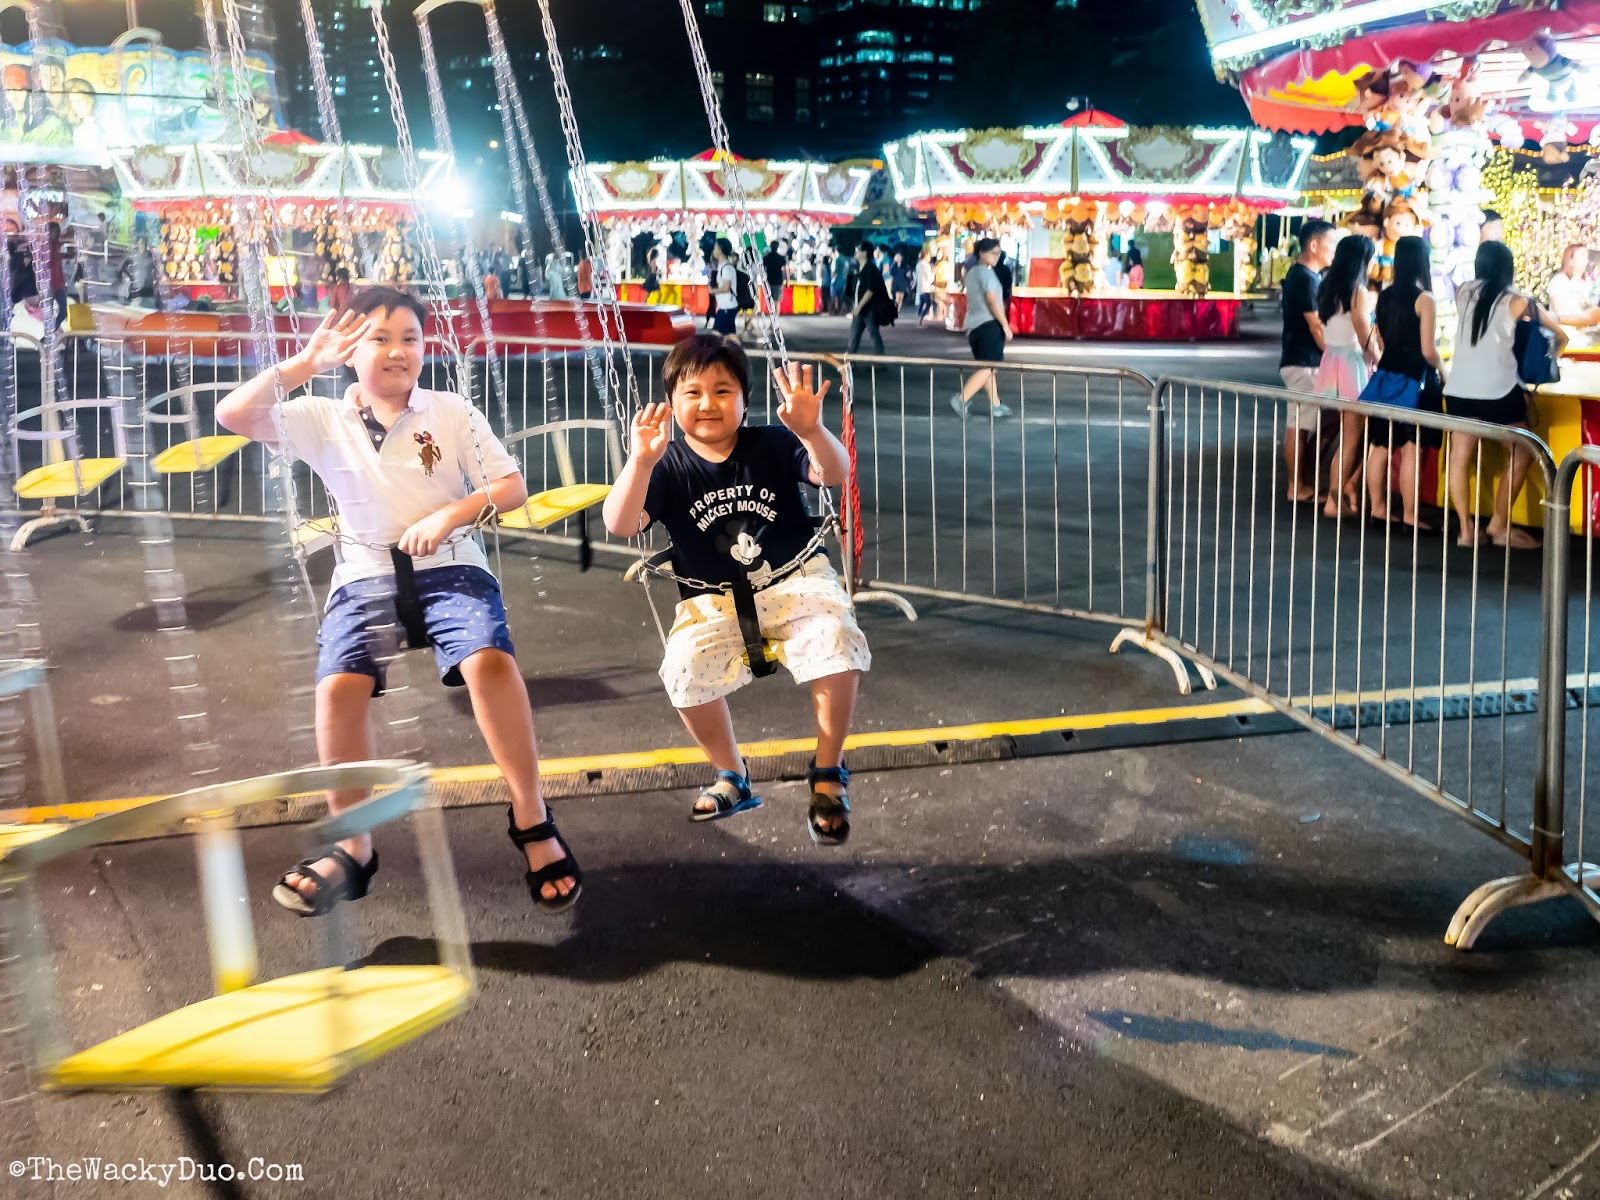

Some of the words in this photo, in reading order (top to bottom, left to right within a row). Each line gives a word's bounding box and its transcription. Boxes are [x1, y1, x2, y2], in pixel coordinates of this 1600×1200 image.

[689, 485, 754, 519] PROPERTY
[760, 488, 776, 503] OF
[696, 502, 734, 532] MICKEY
[737, 500, 777, 522] MOUSE
